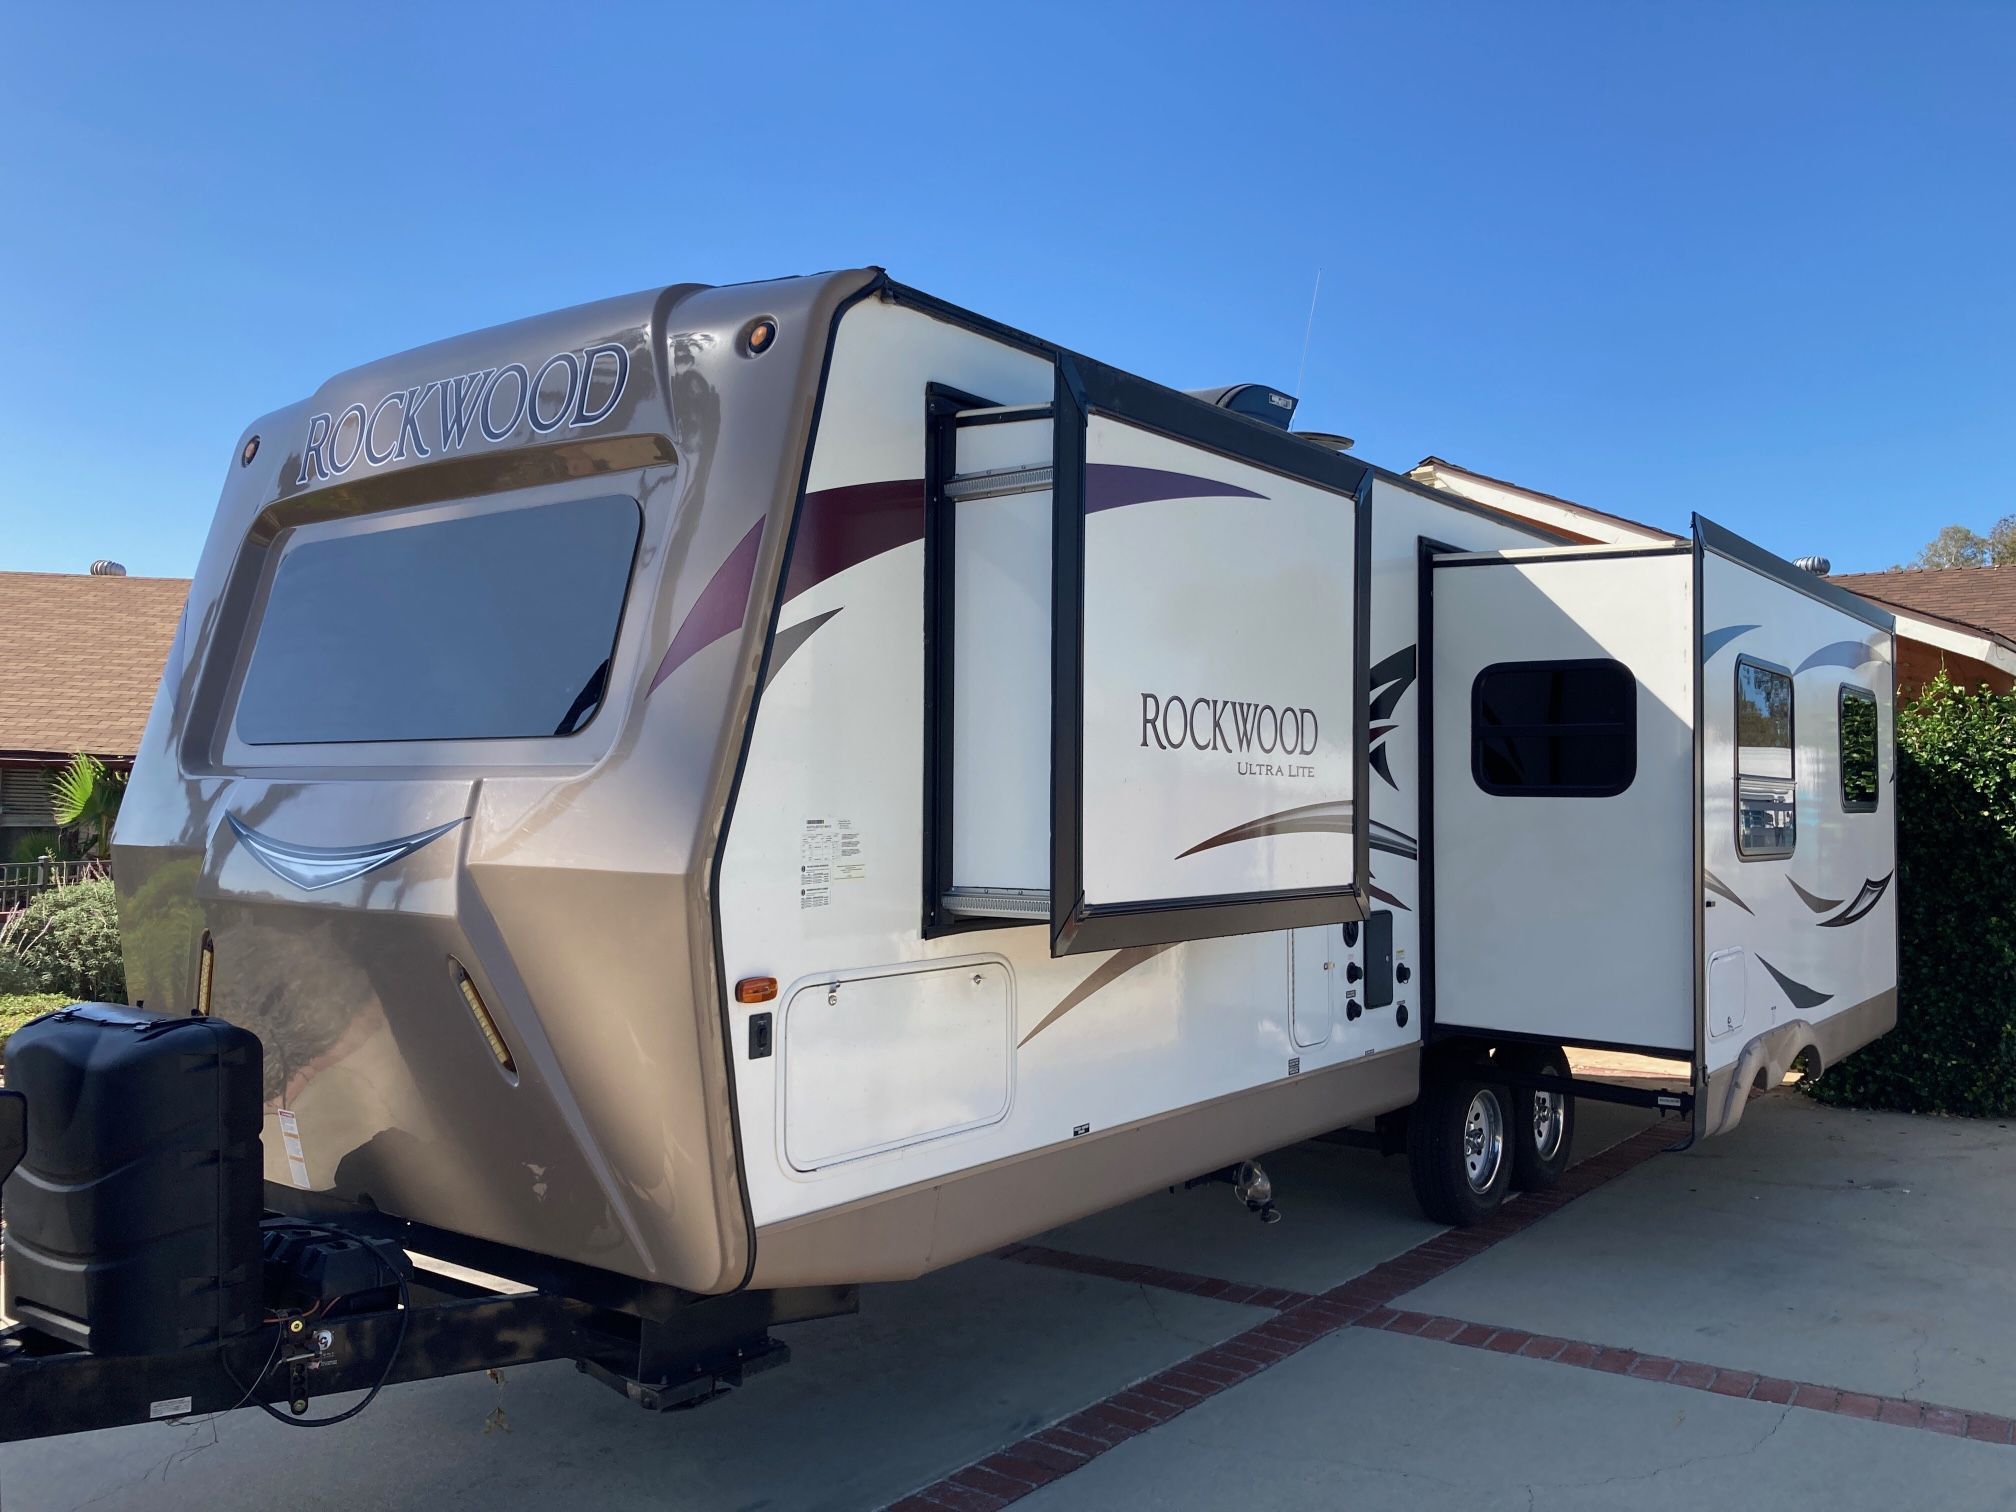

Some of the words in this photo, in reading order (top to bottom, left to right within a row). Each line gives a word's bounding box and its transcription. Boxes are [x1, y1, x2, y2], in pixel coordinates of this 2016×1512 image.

[295, 342, 630, 485] ROCKWOOD
[1140, 692, 1318, 756] ROCKWOOD
[1237, 761, 1284, 777] ULTRA
[1288, 764, 1315, 778] LITE
